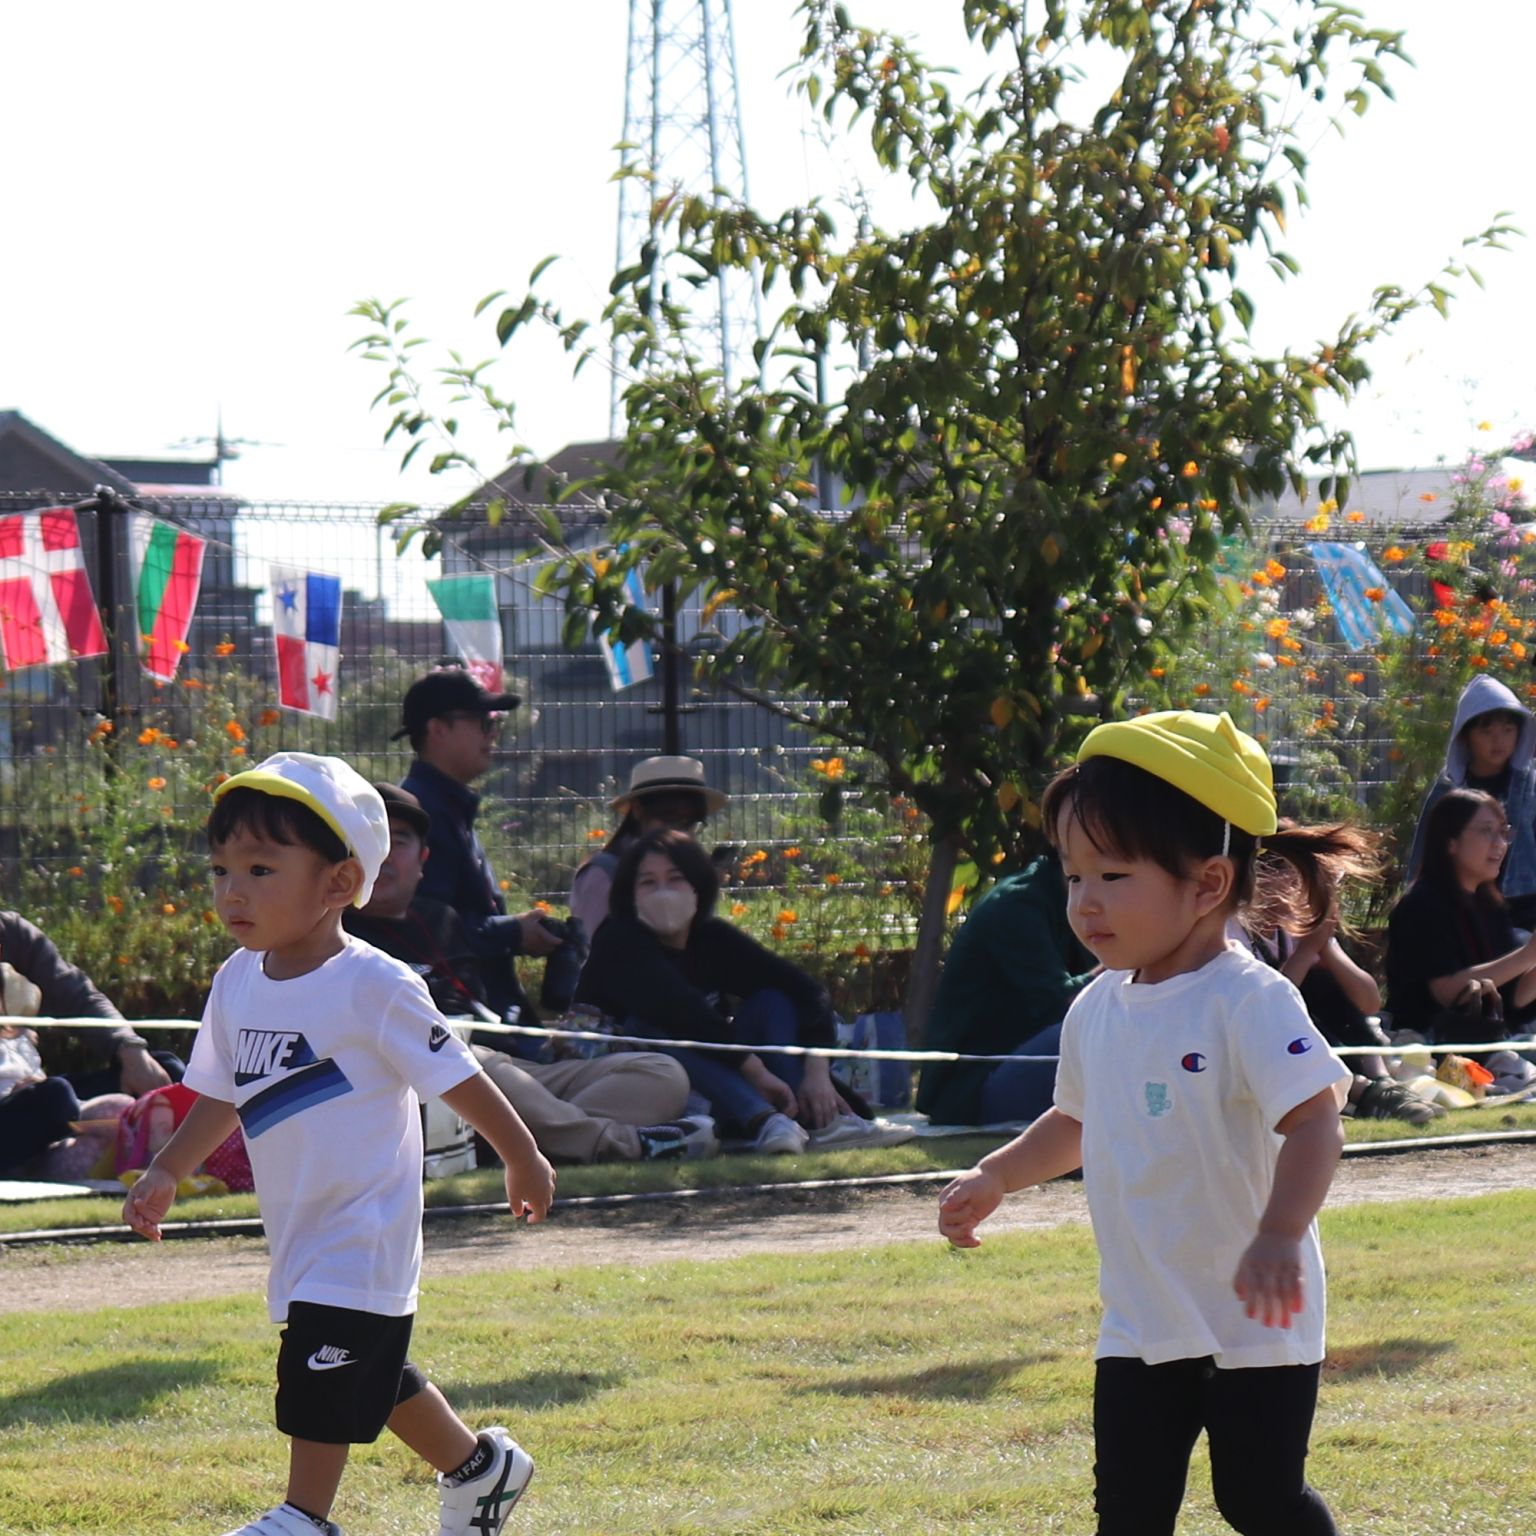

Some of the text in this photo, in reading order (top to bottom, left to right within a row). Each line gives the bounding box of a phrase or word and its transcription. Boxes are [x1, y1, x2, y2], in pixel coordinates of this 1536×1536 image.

[234, 1029, 299, 1075] NIKE
[316, 1344, 350, 1363] NIKE
[464, 1448, 486, 1476] FACE
